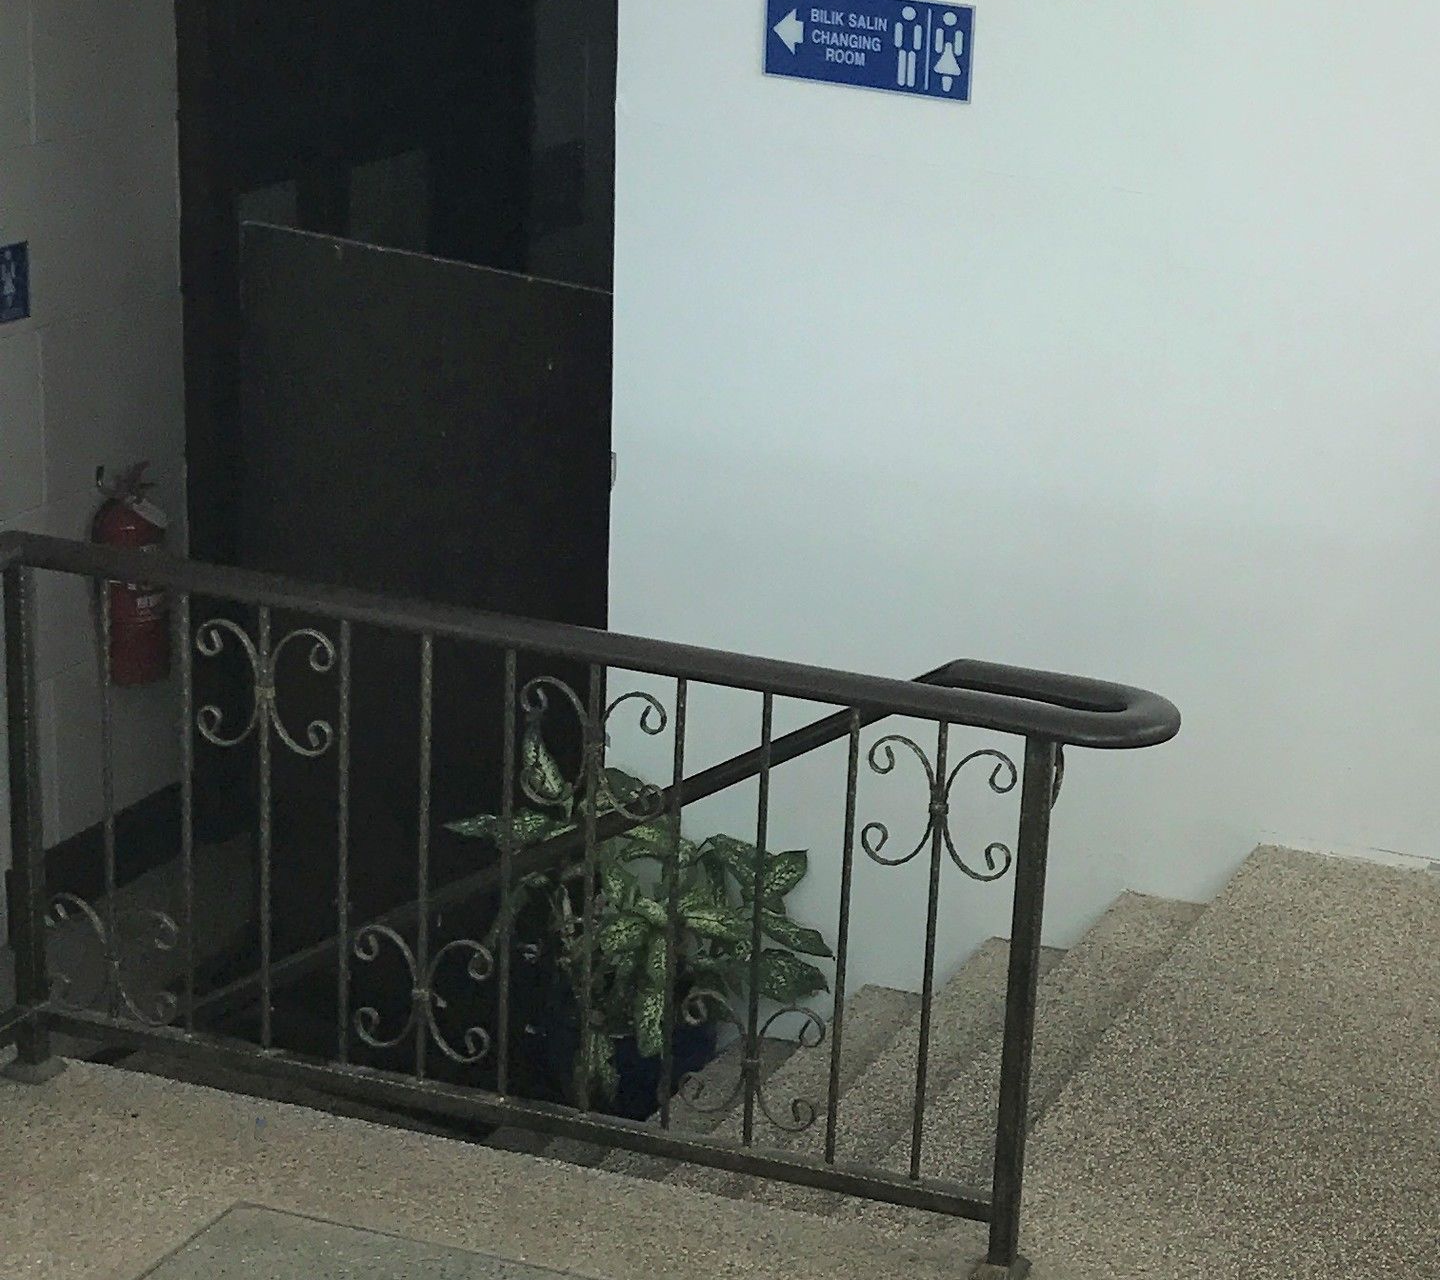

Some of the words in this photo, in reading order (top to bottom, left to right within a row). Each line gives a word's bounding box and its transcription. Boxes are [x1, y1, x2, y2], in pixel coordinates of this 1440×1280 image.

[811, 8, 844, 26] BILIK
[848, 13, 888, 32] SALIN
[811, 29, 882, 52] CHANGING
[825, 48, 866, 67] ROOM
